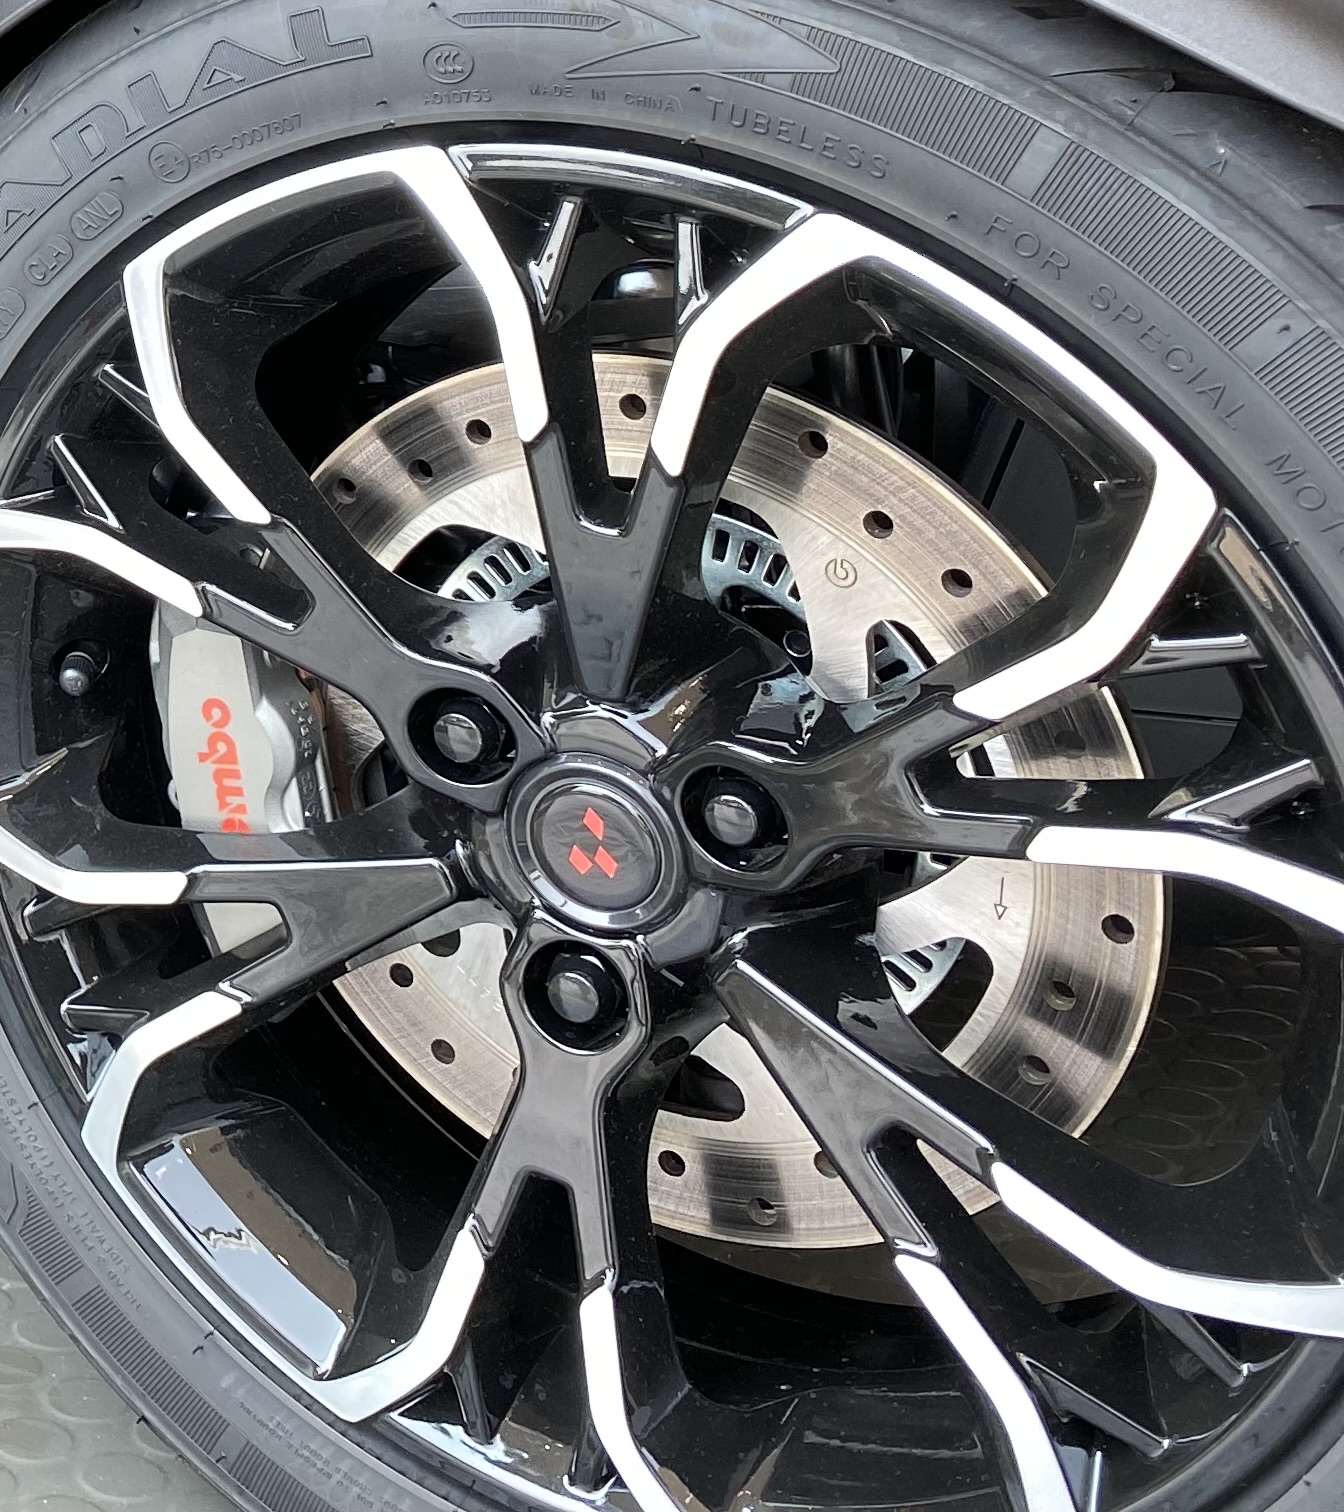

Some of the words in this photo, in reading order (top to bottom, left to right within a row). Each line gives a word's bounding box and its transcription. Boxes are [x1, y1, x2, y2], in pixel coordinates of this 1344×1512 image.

[529, 83, 575, 99] MADE
[591, 87, 606, 102] IN
[624, 91, 677, 112] CHINA
[705, 96, 890, 180] TUBELESS
[984, 214, 1071, 281] FOR
[1087, 282, 1253, 432] SPECIAL
